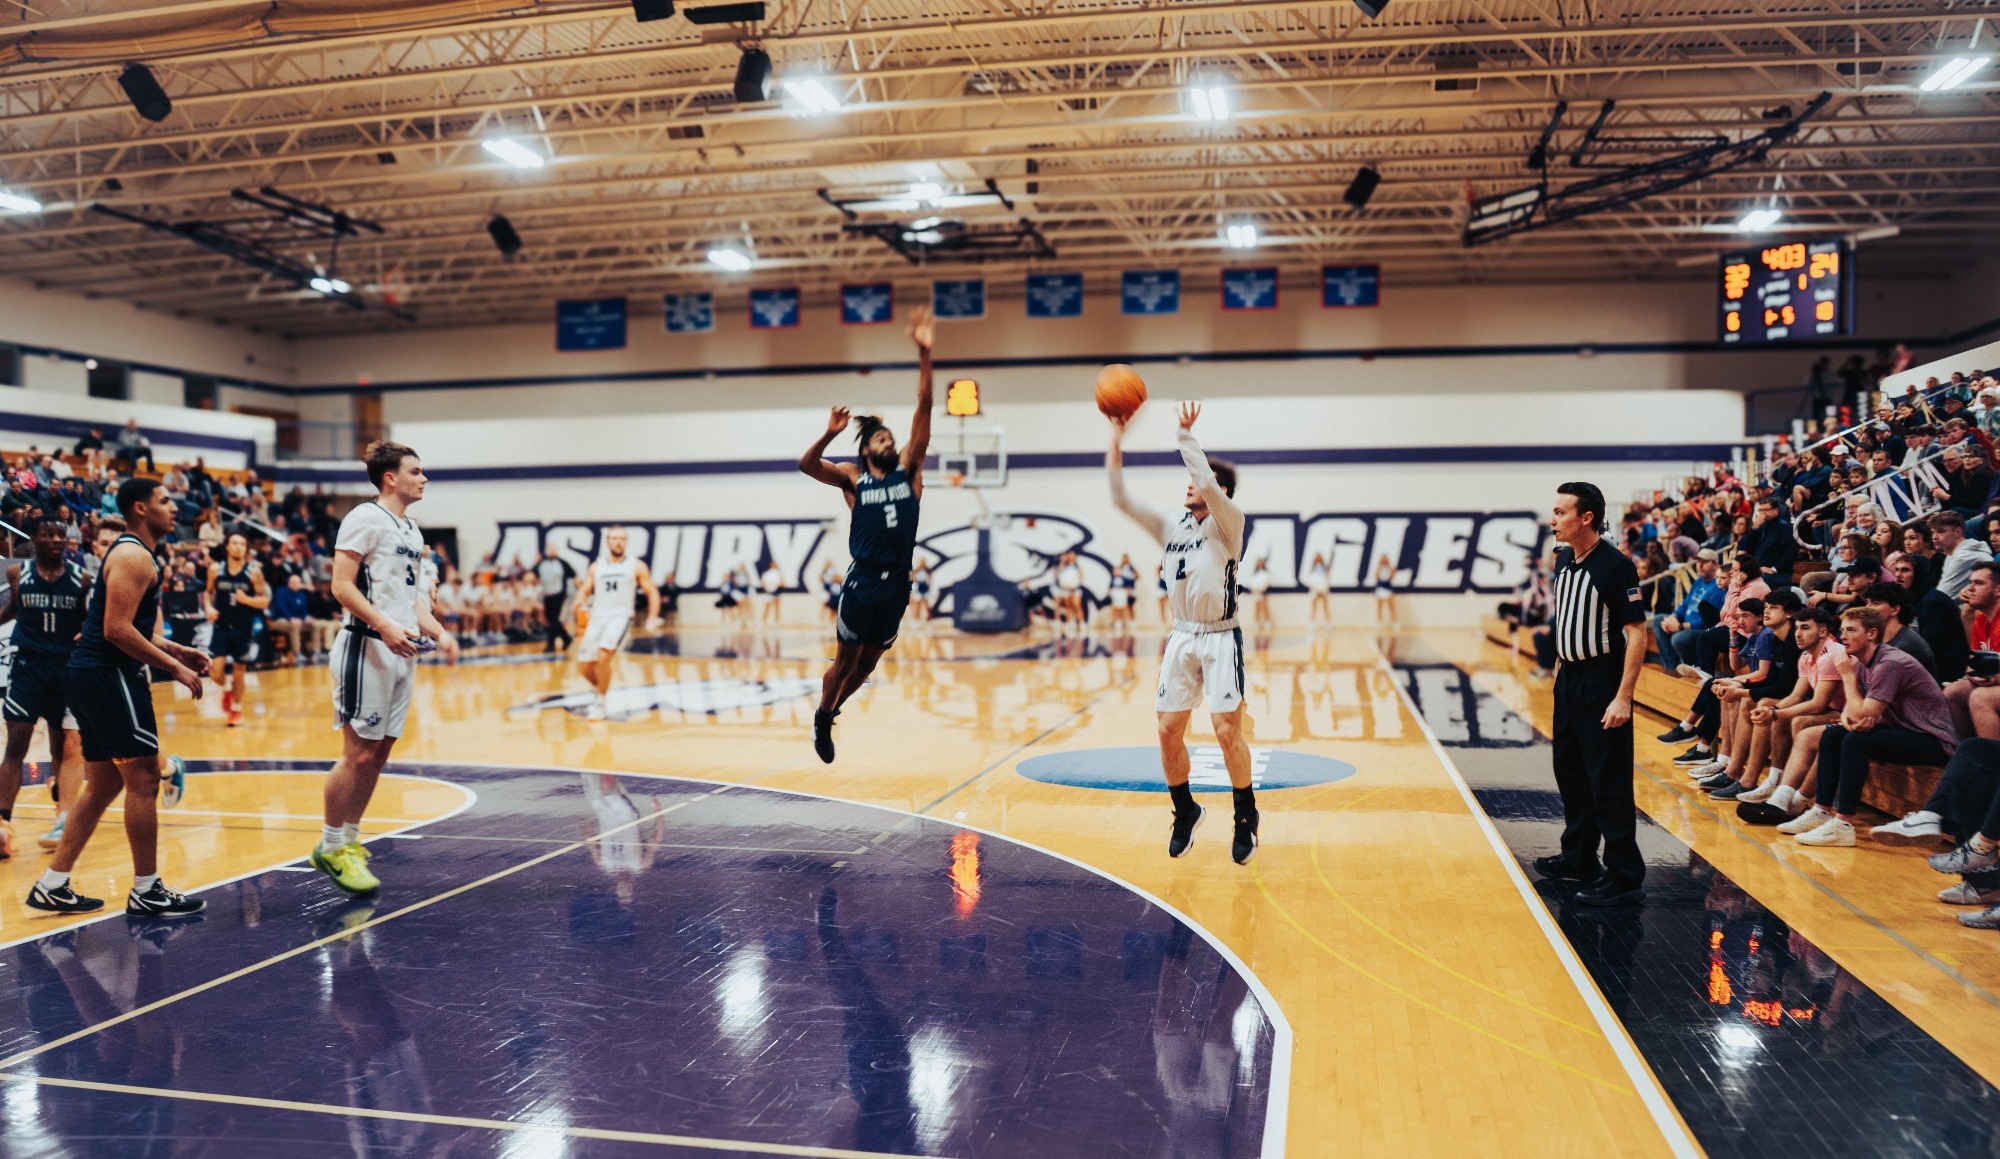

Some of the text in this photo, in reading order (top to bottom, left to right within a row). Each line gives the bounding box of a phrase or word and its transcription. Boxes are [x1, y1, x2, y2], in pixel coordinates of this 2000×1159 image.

[883, 504, 898, 528] 2
[1238, 511, 1538, 593] AGLES
[406, 564, 415, 586] 3
[43, 611, 56, 632] 11
